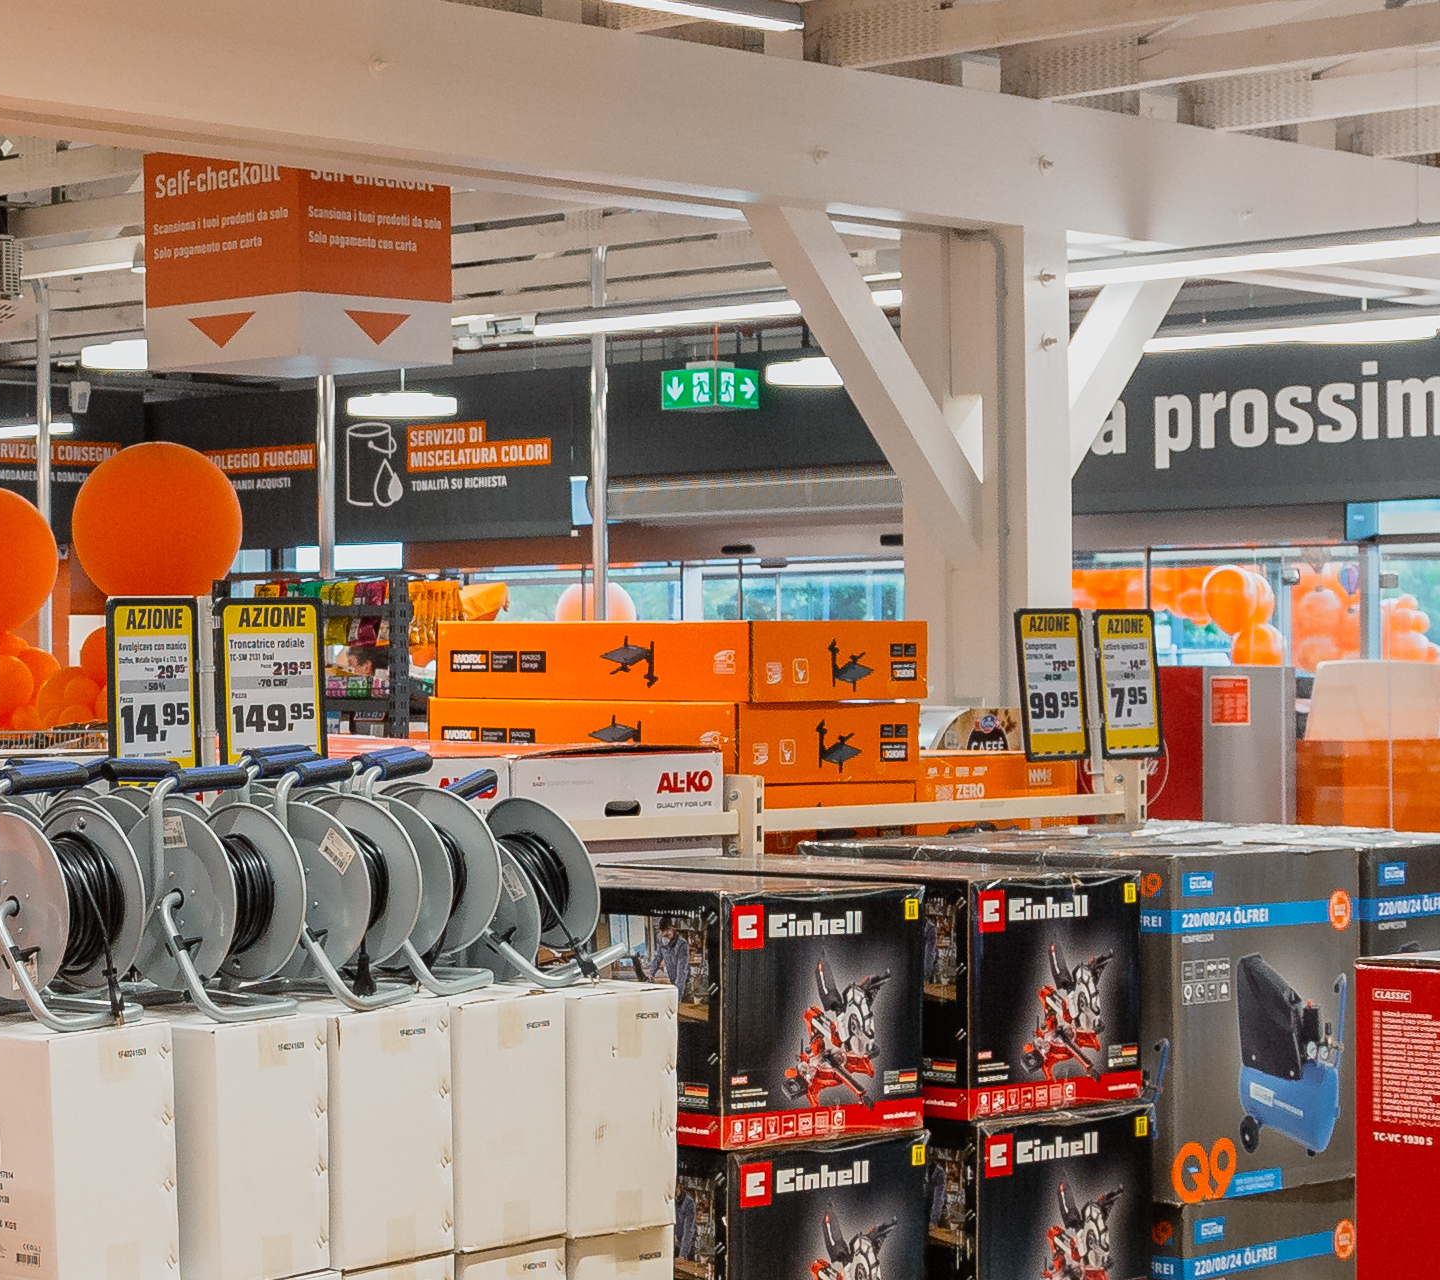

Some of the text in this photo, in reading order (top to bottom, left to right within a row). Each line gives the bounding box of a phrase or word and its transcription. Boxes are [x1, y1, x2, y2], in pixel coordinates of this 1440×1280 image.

[155, 161, 281, 199] Self-checkout
[154, 219, 196, 236] Scansiona
[203, 217, 220, 229] tuoi
[221, 211, 256, 229] prodotti
[257, 210, 268, 221] da
[269, 207, 289, 220] solo
[308, 205, 352, 222] Scansiona
[358, 210, 375, 223] tuoi
[376, 212, 411, 229] prodotti
[412, 215, 423, 227] da
[424, 217, 442, 230] solo
[154, 236, 263, 260] Solo pagamento con carta
[308, 230, 418, 252] Solo pagamento con carta
[409, 426, 483, 447] SERVIZIO DI
[410, 443, 548, 468] MISCELATURA COLORI
[257, 478, 291, 489] ACQUISTI
[411, 475, 507, 492] TONALITÀ SU RICHIESTA
[126, 608, 183, 630] AZIONE
[238, 606, 306, 628] AZIONE
[1029, 616, 1070, 632] AZIONE
[1108, 619, 1144, 634] AZIONE
[154, 643, 165, 651] con
[166, 641, 187, 651] manico
[229, 638, 305, 650] Troncatrice radiale
[453, 653, 484, 663] WORX
[231, 692, 247, 700] Pezzo
[1029, 691, 1078, 719] 99,95
[1110, 686, 1147, 718] 7,95
[121, 702, 190, 744] 14,95
[232, 703, 315, 734] 149,95
[443, 729, 474, 740] WORX
[656, 770, 713, 795] AL-KO
[955, 784, 984, 800] ZERO
[656, 800, 713, 809] QUALITY FOR LIFE
[1009, 894, 1088, 920] Einhell
[1182, 907, 1269, 928] 220/08/24 ÖLFREI
[1378, 901, 1421, 917] 220/08/24
[768, 910, 862, 937] Einhell
[1374, 990, 1410, 1001] CLASSIC
[1373, 1131, 1401, 1143] TC-VC
[1402, 1134, 1425, 1145] 1930
[776, 1161, 870, 1193] Einhell
[1172, 1137, 1237, 1204] Q9
[1194, 1245, 1278, 1277] 220/08/24 ÖLFREI
